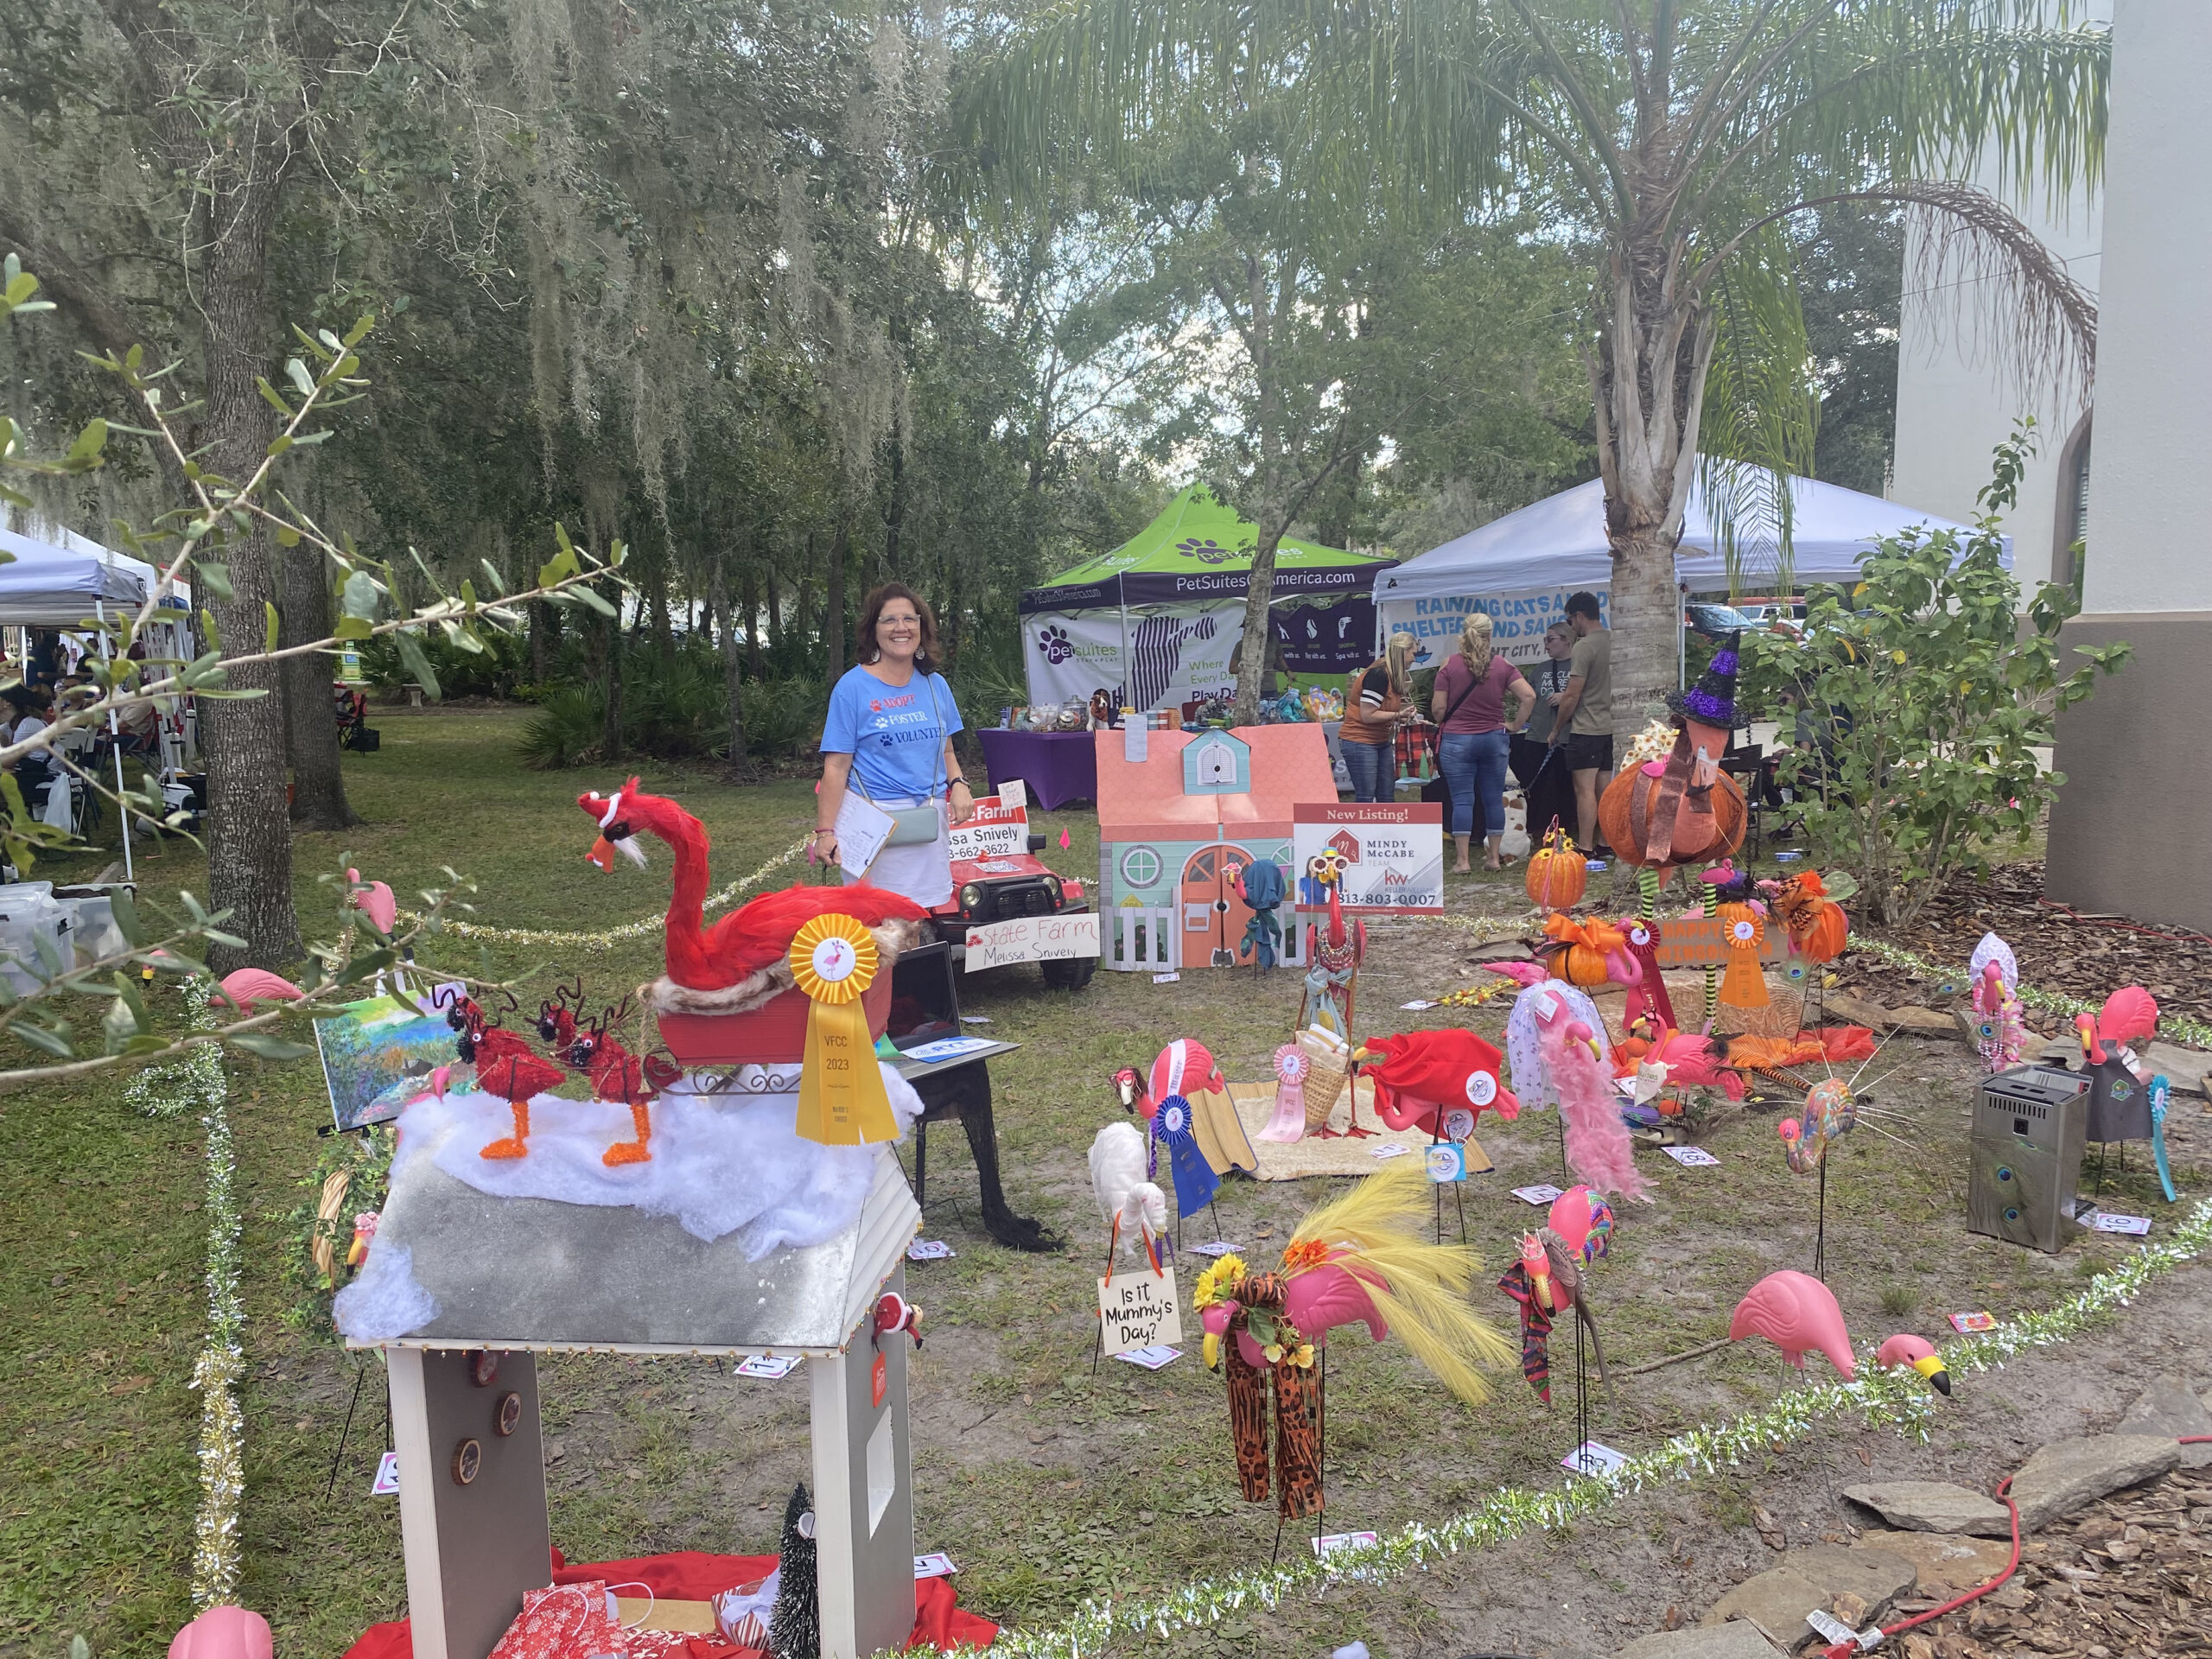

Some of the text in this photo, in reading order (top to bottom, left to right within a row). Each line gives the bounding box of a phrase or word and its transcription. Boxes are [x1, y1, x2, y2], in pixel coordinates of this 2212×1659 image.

[1176, 570, 1355, 591] PetSuitesmerica.com
[1415, 596, 1501, 617] RAINING
[1503, 595, 1550, 617] CATS
[1189, 660, 1224, 671] Where
[1191, 674, 1217, 684] Every
[883, 694, 915, 709] ADOPT
[1192, 688, 1237, 702] Play Da
[888, 710, 929, 725] FOSTER
[976, 804, 1013, 821] Farm
[1327, 809, 1408, 823] New Listing!
[974, 826, 1018, 842] Snively
[1367, 840, 1408, 849] MINDY
[1367, 849, 1415, 858] McCABE
[1384, 869, 1408, 886] kw
[1338, 893, 1436, 906] 813-803-0007
[983, 918, 1098, 947] State Farm
[1662, 921, 1721, 939] HAPPY
[983, 942, 1077, 966] Melissa Snively
[823, 1035, 848, 1047] VFCC
[826, 1058, 849, 1071] 2023
[2105, 1217, 2132, 1229] 16
[1121, 1281, 1151, 1306] Is it
[1105, 1299, 1173, 1327] Mummy's
[1121, 1322, 1157, 1346] Day?
